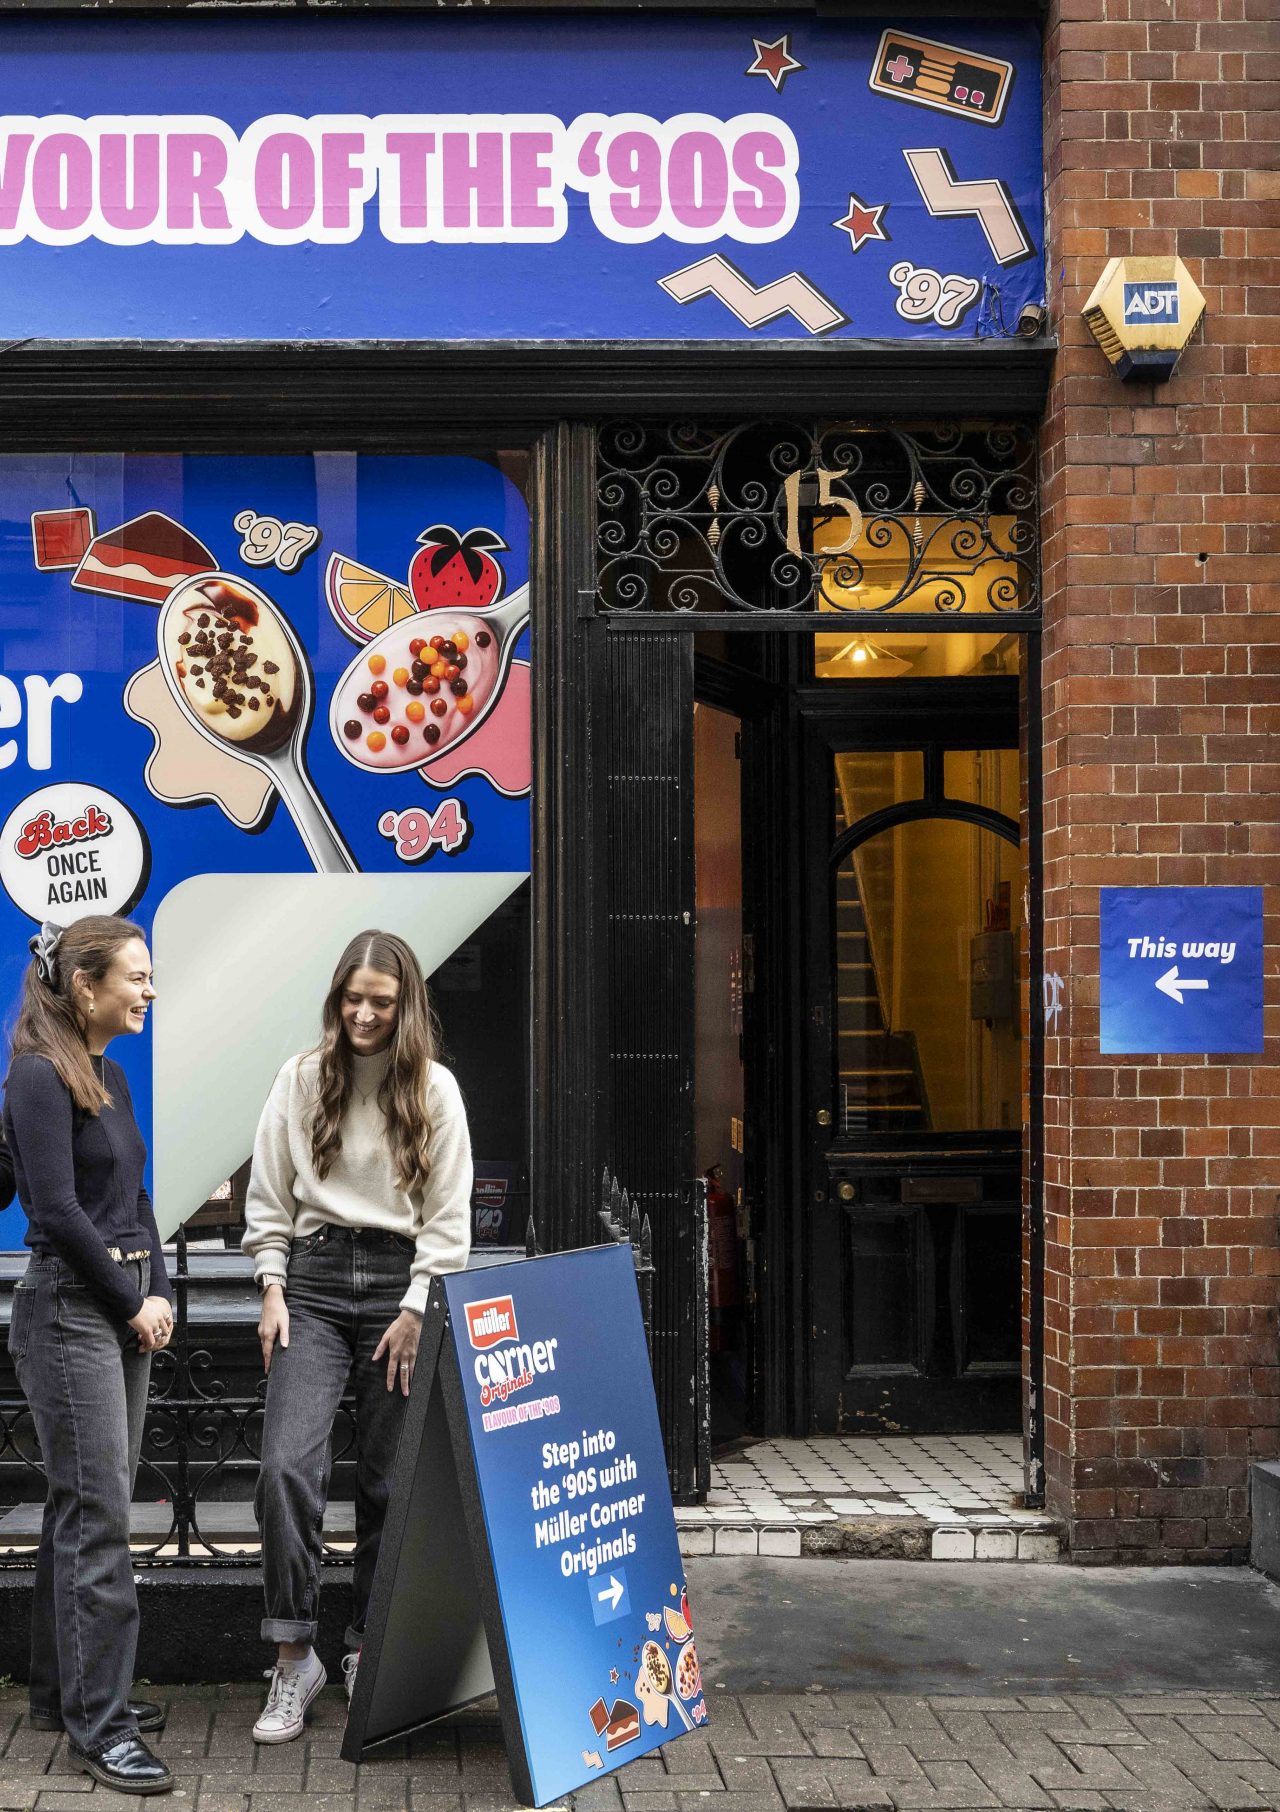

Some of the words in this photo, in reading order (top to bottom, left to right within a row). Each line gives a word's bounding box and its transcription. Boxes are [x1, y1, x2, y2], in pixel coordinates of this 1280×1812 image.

[254, 132, 365, 230] OF
[385, 132, 554, 229] THE
[1125, 291, 1178, 315] ADT
[784, 468, 863, 559] 15
[17, 806, 110, 857] Back
[47, 849, 101, 878] ONCE
[47, 877, 107, 905] AGAIN
[1127, 936, 1177, 958] This
[1182, 940, 1236, 964] way
[473, 1307, 511, 1337] müller
[474, 1338, 558, 1386] corner
[481, 1368, 533, 1406] Originals
[483, 1407, 518, 1430] FLAVOUR
[518, 1404, 529, 1420] OF
[529, 1401, 542, 1418] THE
[542, 1442, 580, 1469] Step
[582, 1429, 616, 1457] into
[531, 1480, 560, 1510] the
[599, 1453, 637, 1488] with
[534, 1509, 588, 1549] Müller
[590, 1493, 646, 1528] Corner
[560, 1527, 637, 1577] Originals
